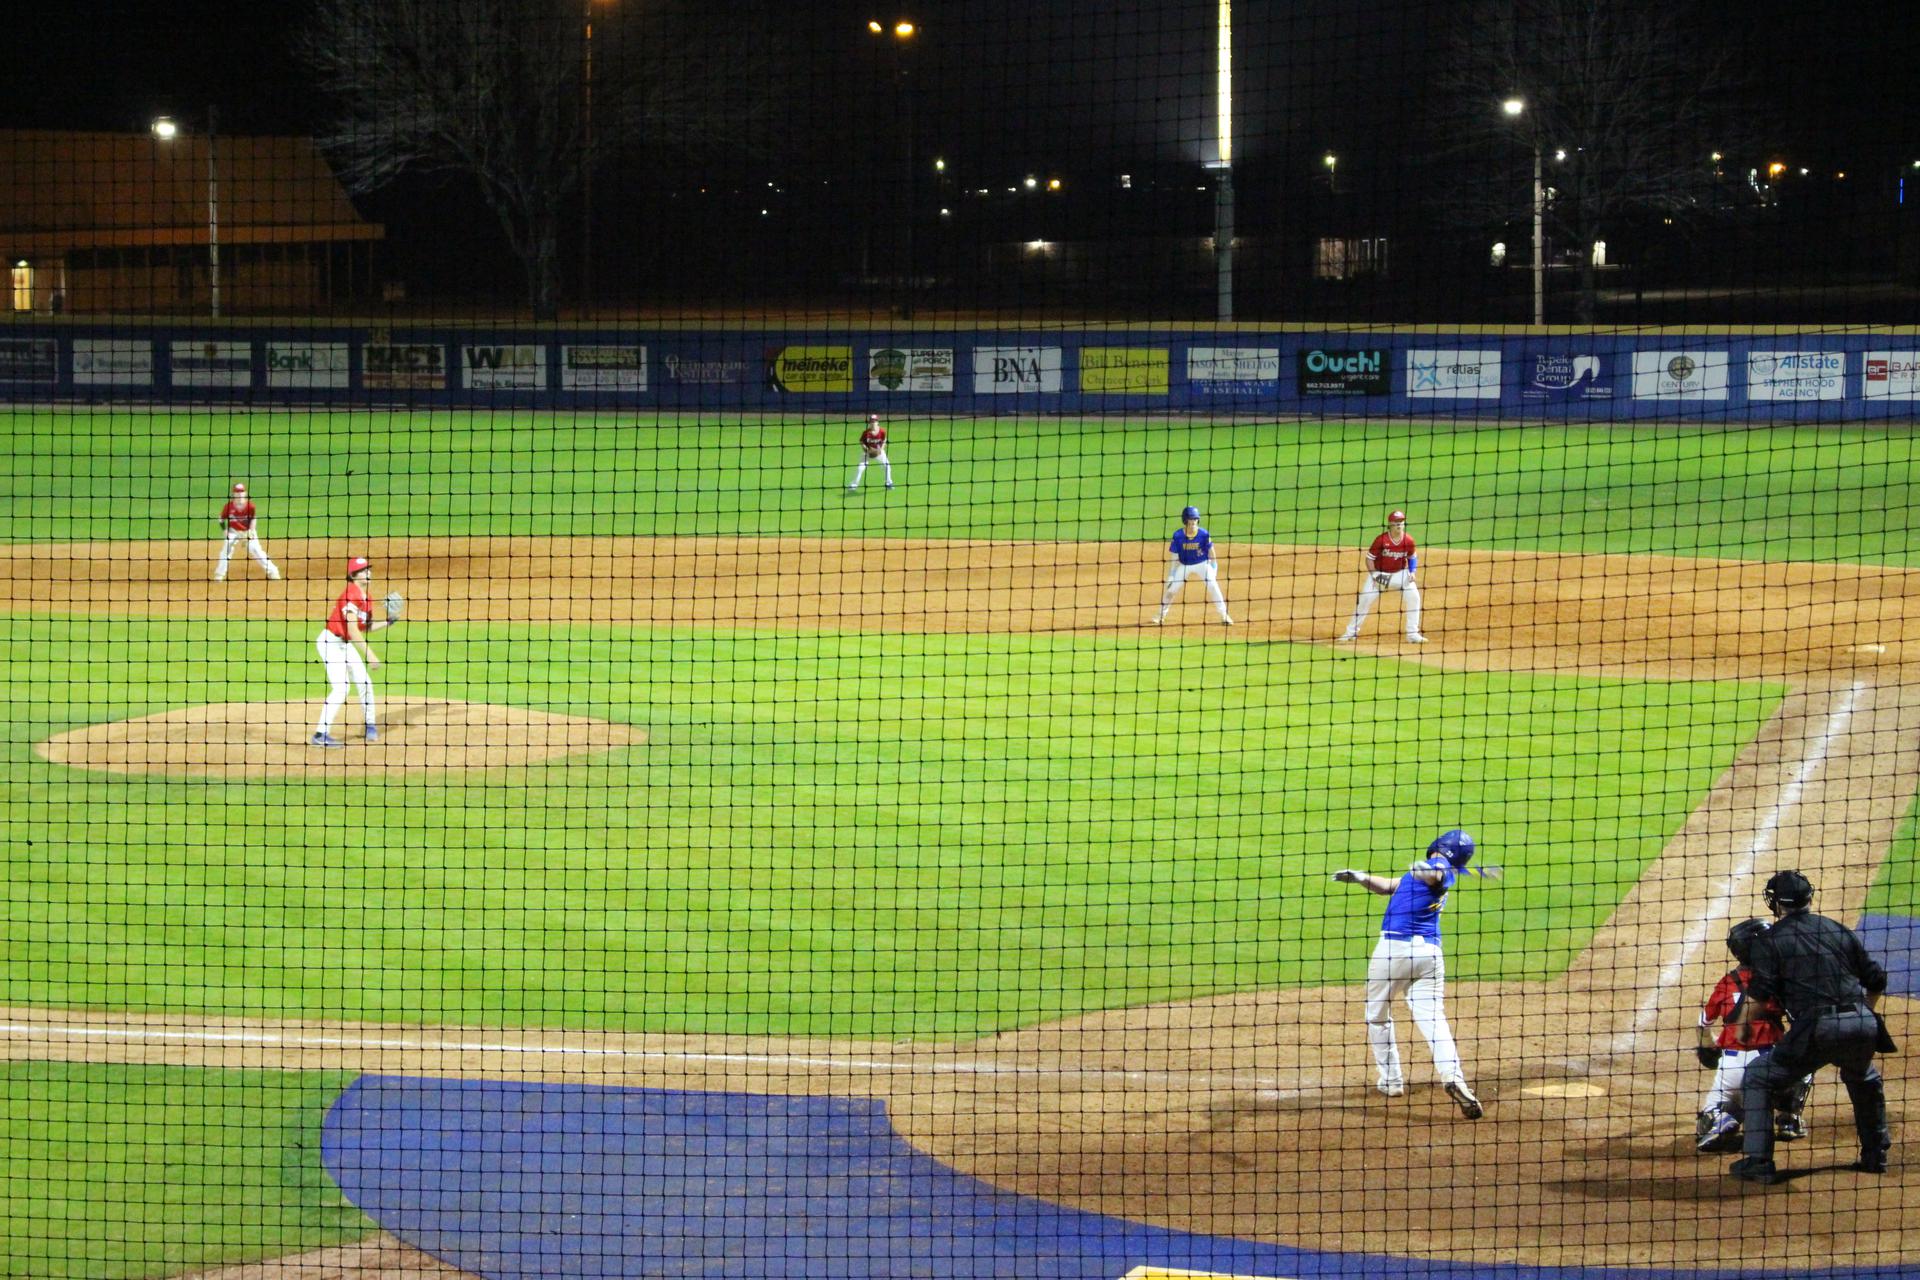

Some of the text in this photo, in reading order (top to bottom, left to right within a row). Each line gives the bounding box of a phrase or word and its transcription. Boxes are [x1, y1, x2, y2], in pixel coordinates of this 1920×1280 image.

[783, 357, 849, 372] meineke
[1084, 355, 1108, 368] Bill
[1306, 350, 1381, 373] Ouch!
[1780, 354, 1840, 369] Allstate
[992, 358, 1042, 383] BNA
[1446, 364, 1482, 375] relias
[1536, 364, 1572, 374] Dental
[1536, 373, 1571, 385] Group
[1805, 379, 1835, 388] HOOD
[1779, 388, 1820, 398] AGENCY
